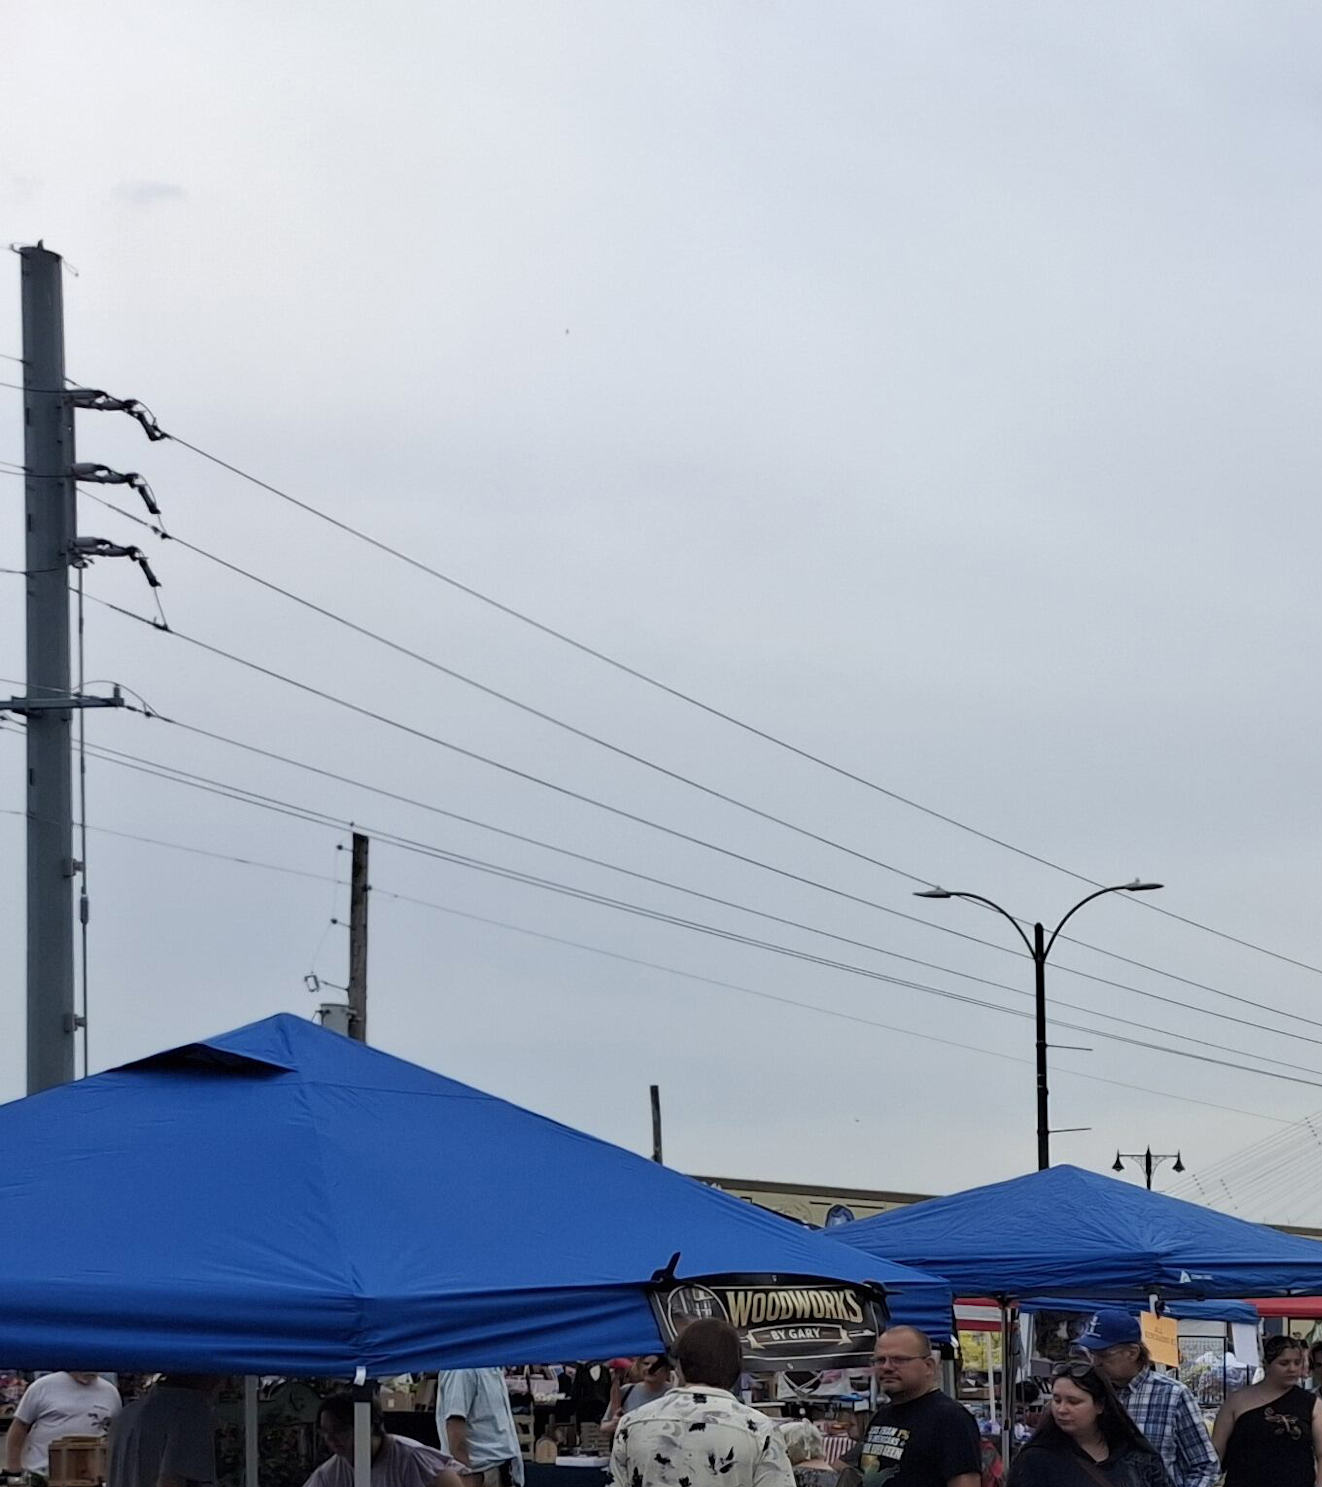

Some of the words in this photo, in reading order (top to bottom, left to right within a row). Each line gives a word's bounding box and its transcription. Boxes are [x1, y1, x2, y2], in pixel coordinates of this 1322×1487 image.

[726, 1290, 864, 1328] WOODWORKS
[771, 1329, 787, 1340] BY
[789, 1328, 821, 1340] GARY
